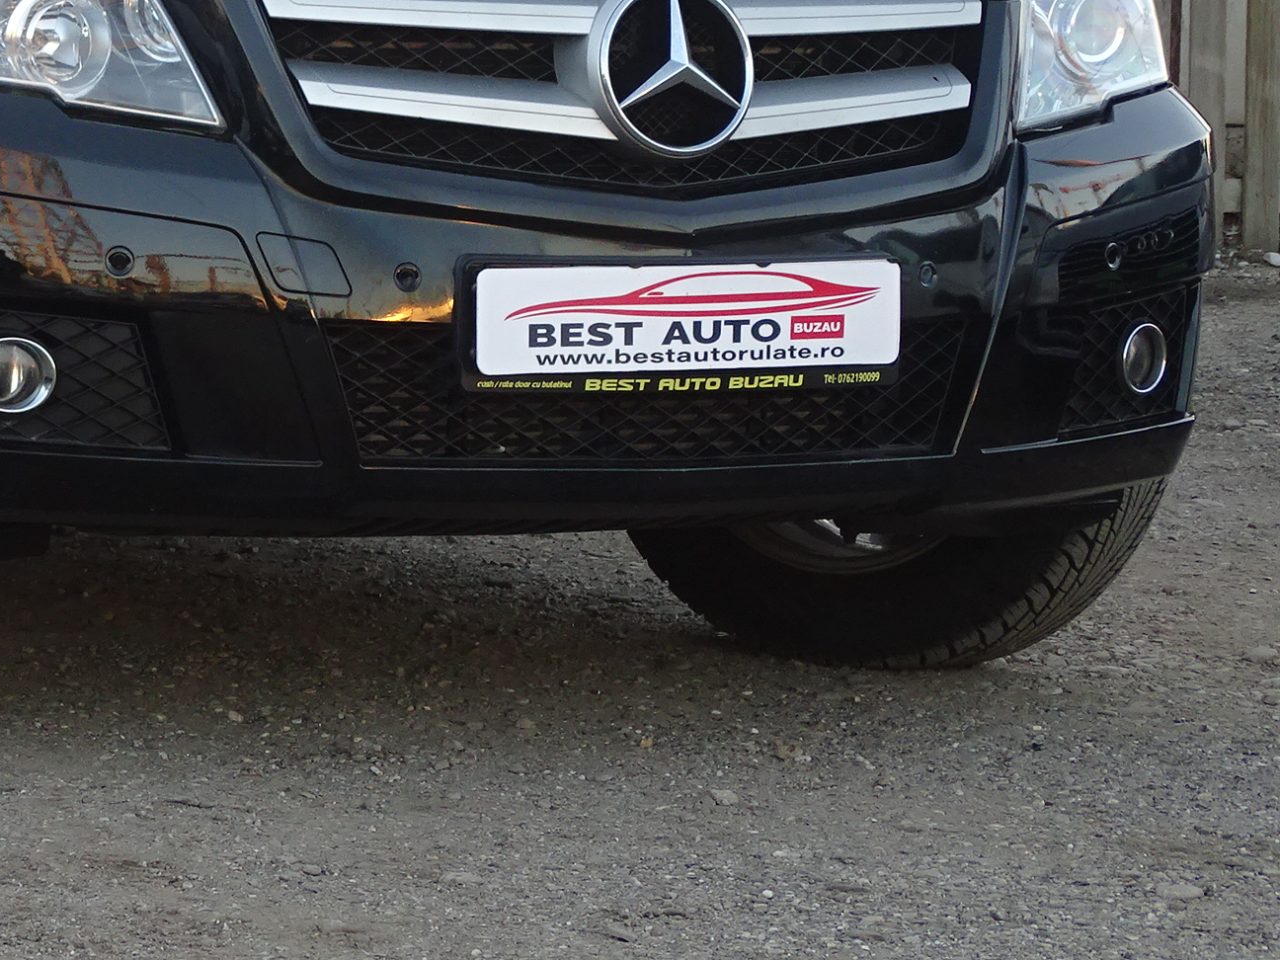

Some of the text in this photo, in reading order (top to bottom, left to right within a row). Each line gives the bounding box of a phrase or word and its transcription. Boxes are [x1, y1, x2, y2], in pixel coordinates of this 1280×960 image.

[528, 318, 781, 348] BEST AUTO
[793, 321, 841, 334] BUZAU
[536, 344, 845, 366] www.bestautorulate.ro
[585, 374, 804, 391] BEST AUTO BUZAU
